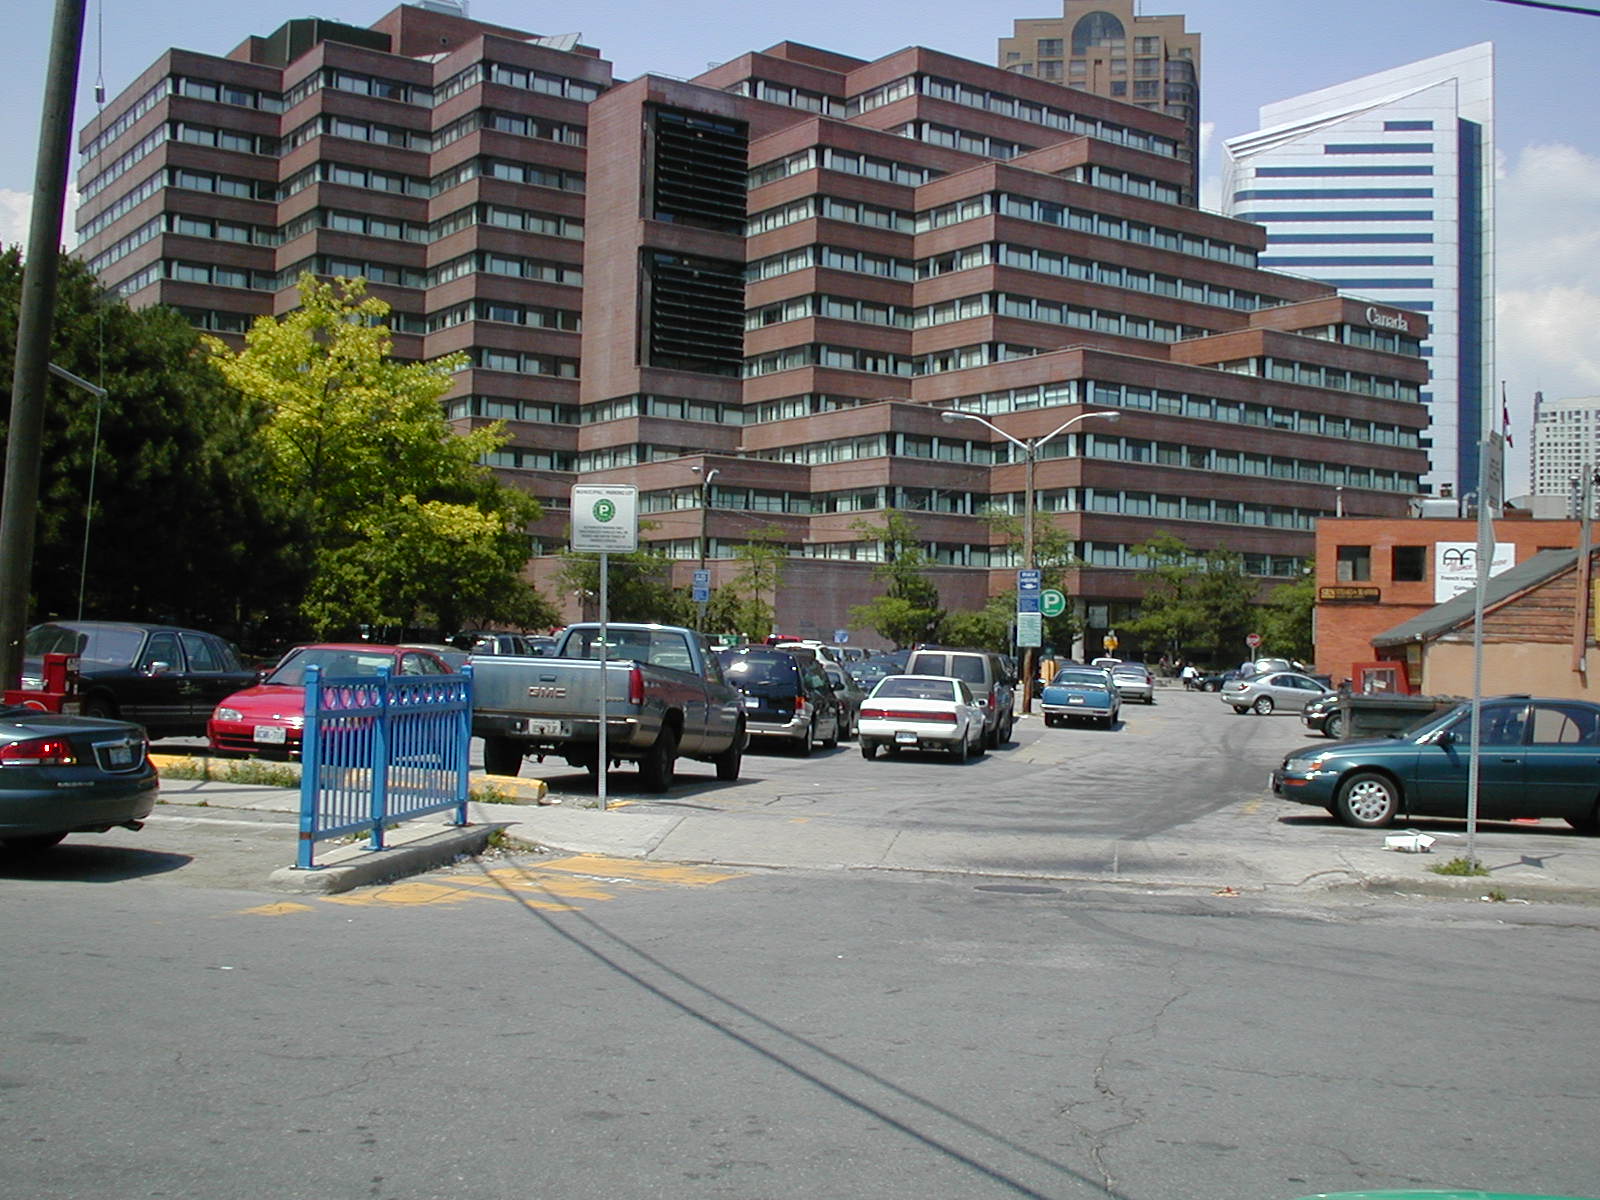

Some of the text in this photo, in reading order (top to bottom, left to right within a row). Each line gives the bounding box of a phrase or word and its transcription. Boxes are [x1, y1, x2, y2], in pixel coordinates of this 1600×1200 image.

[1366, 306, 1409, 332] Canada
[1044, 593, 1060, 609] P
[528, 686, 567, 698] GMC
